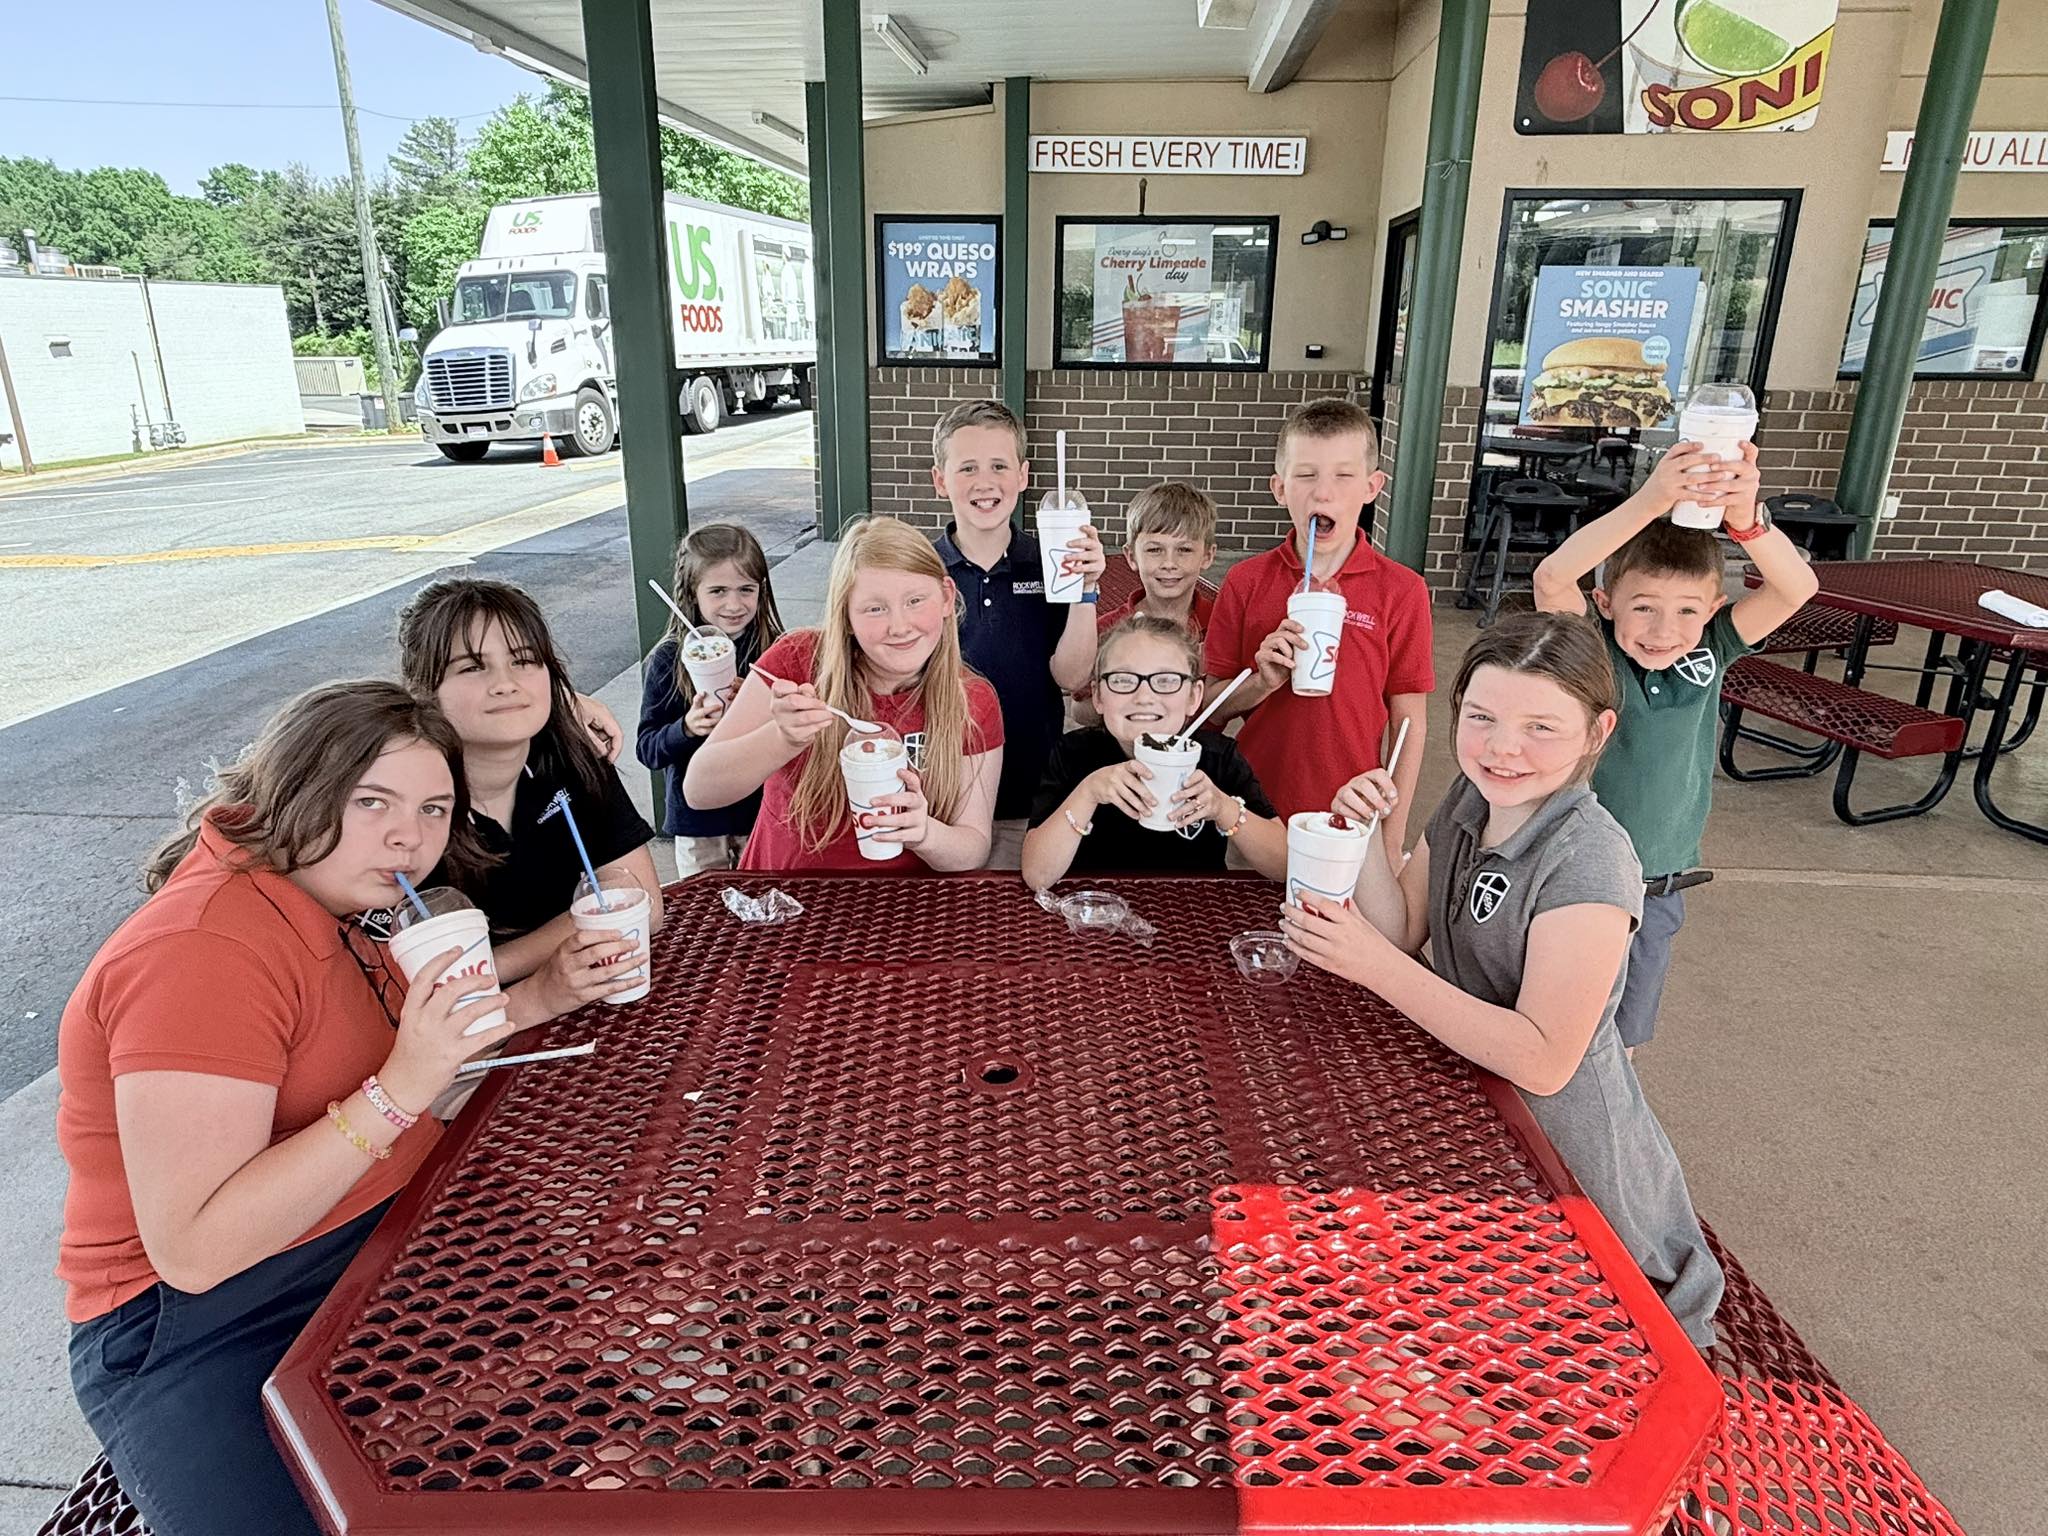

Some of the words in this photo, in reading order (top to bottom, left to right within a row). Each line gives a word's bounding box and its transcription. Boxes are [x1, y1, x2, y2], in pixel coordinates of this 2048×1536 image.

[1035, 140, 1122, 168] FRESH
[1132, 141, 1221, 168] EVERY
[1228, 142, 1300, 169] TIME!
[927, 242, 995, 260] QUESO
[905, 261, 977, 278] WRAPS
[1100, 257, 1146, 272] Cherry
[1149, 256, 1207, 269] Limeade
[1165, 267, 1189, 283] day
[1581, 280, 1653, 299] SONIC
[1559, 299, 1669, 319] SMASHER
[680, 304, 723, 333] FOODS
